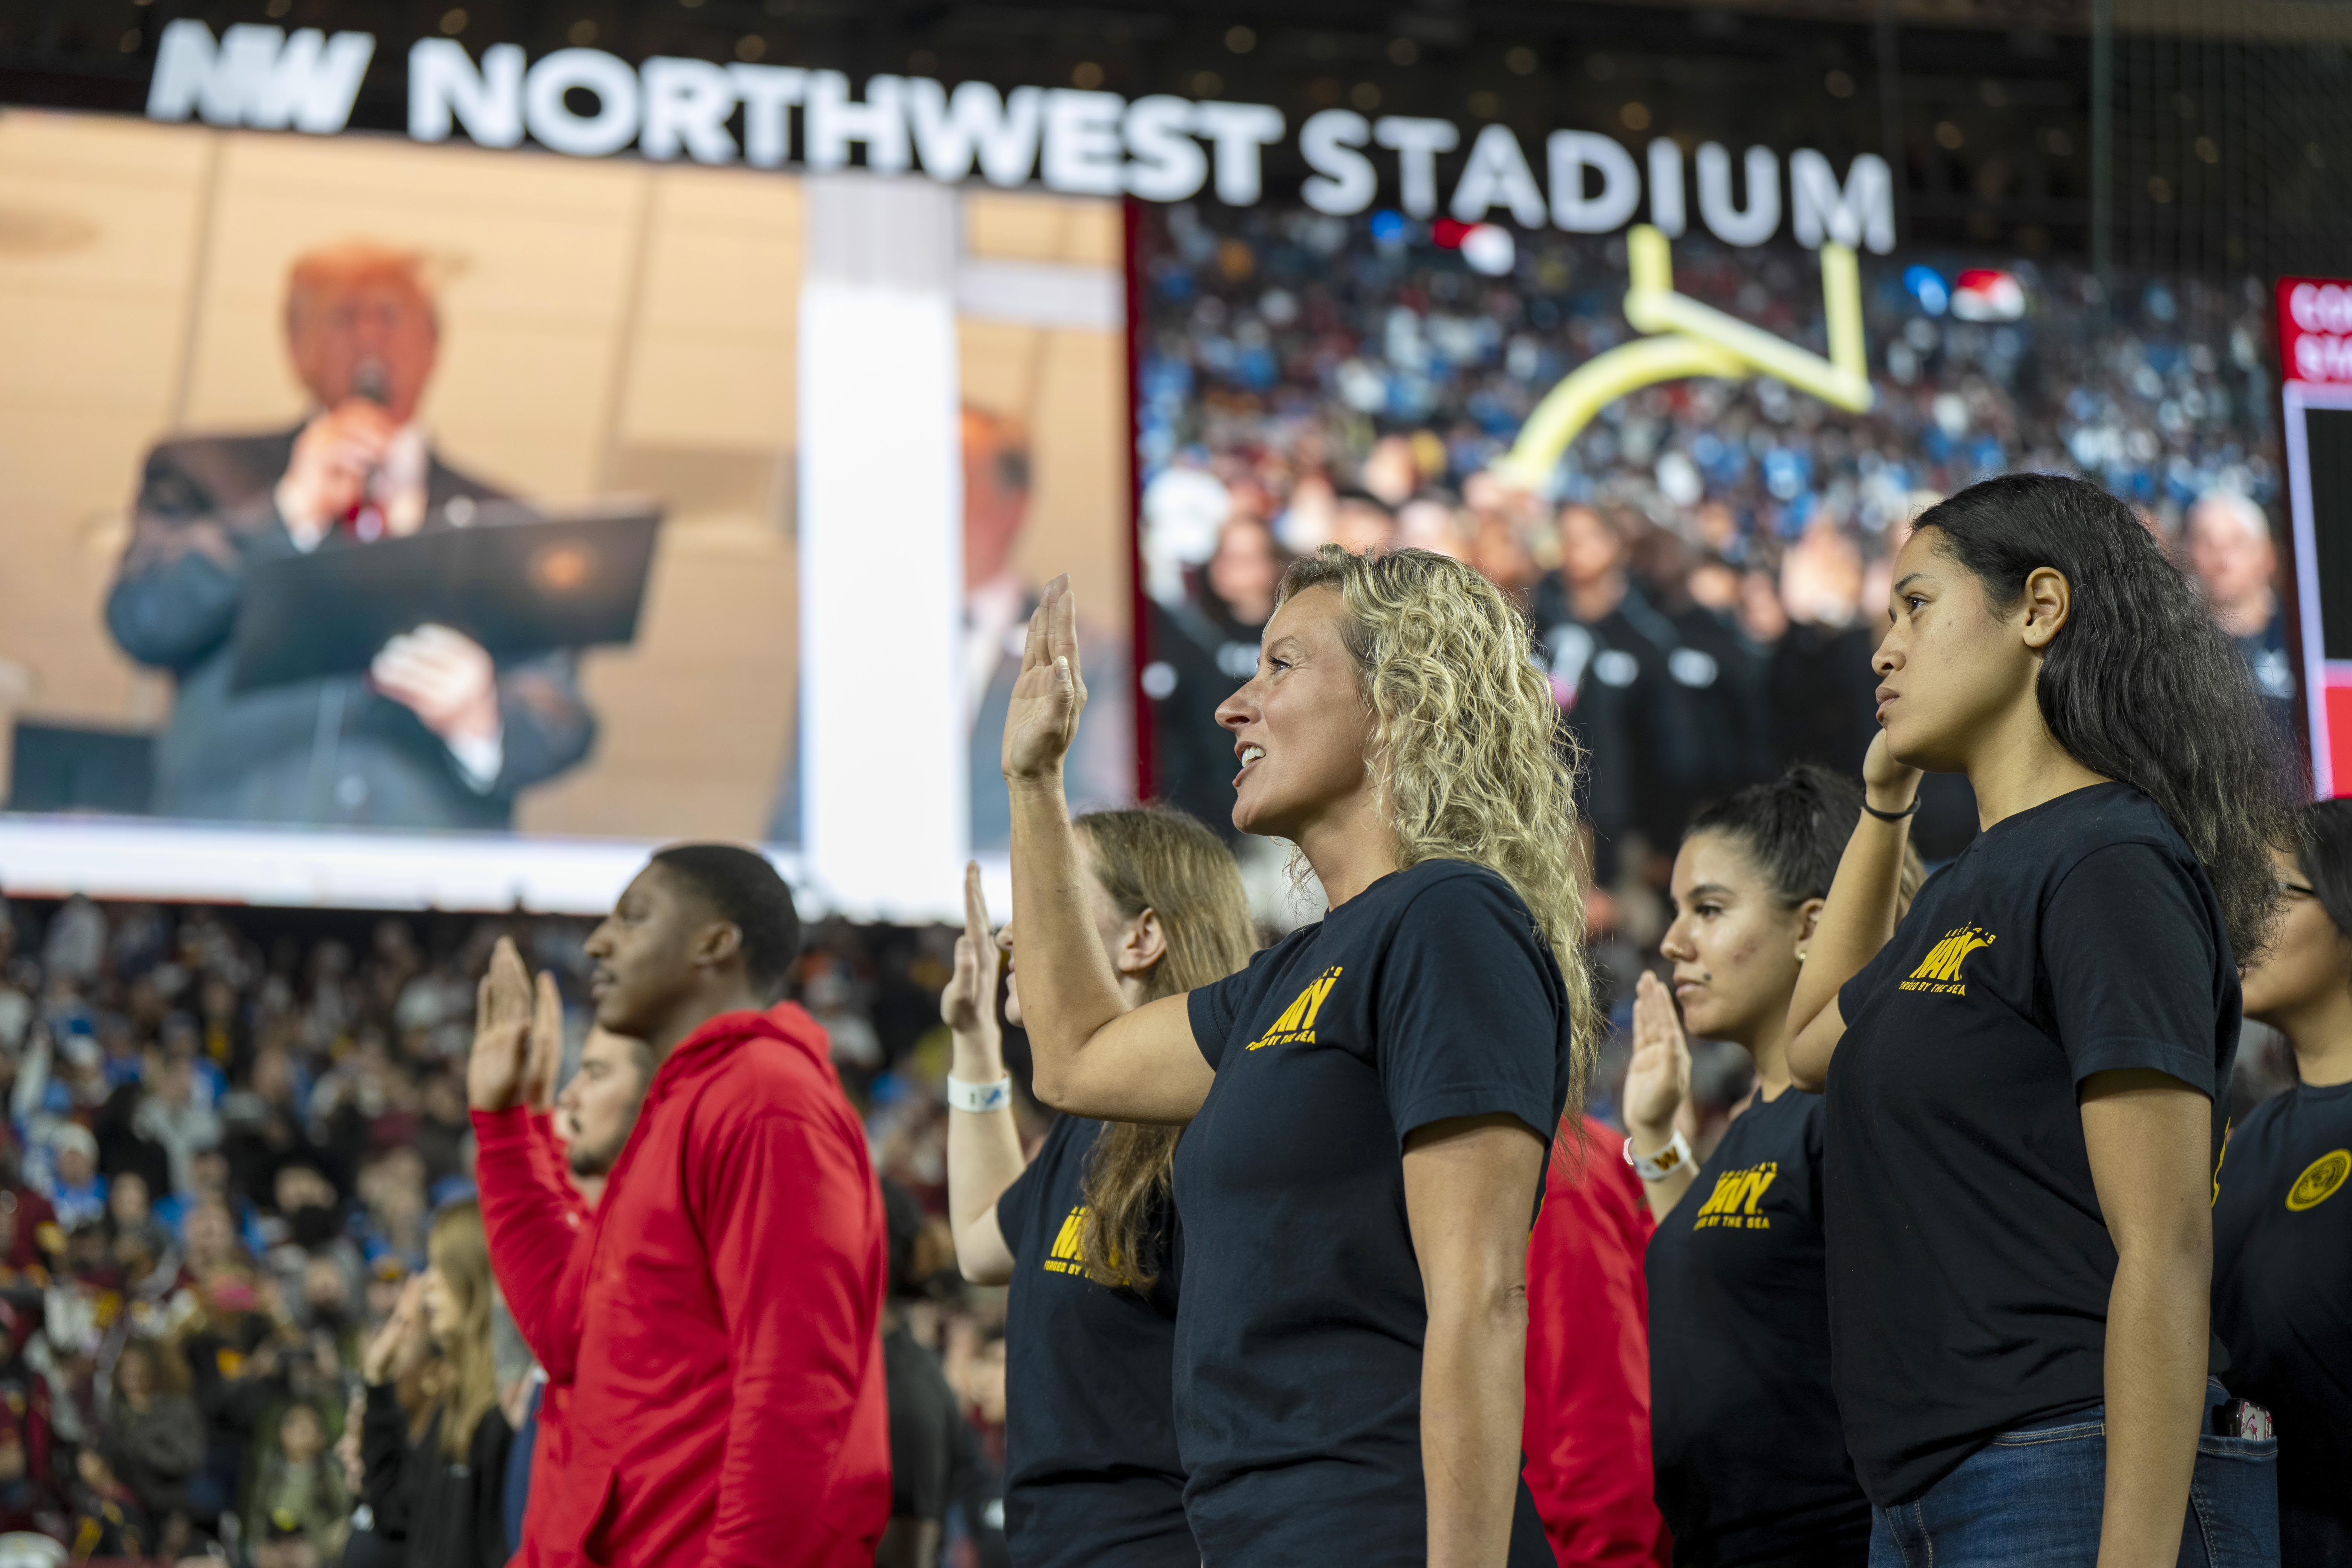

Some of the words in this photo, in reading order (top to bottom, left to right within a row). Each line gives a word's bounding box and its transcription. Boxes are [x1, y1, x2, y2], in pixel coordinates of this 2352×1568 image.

[406, 35, 1285, 204] NORTHWEST
[1299, 108, 1896, 255] STADIUM
[1909, 931, 1989, 982] NAVY
[1899, 981, 1920, 991] ORGED
[1917, 982, 1932, 992] BY
[1931, 984, 1949, 993] THE
[1946, 984, 1965, 996] SEA
[1068, 1263, 1082, 1276] BY
